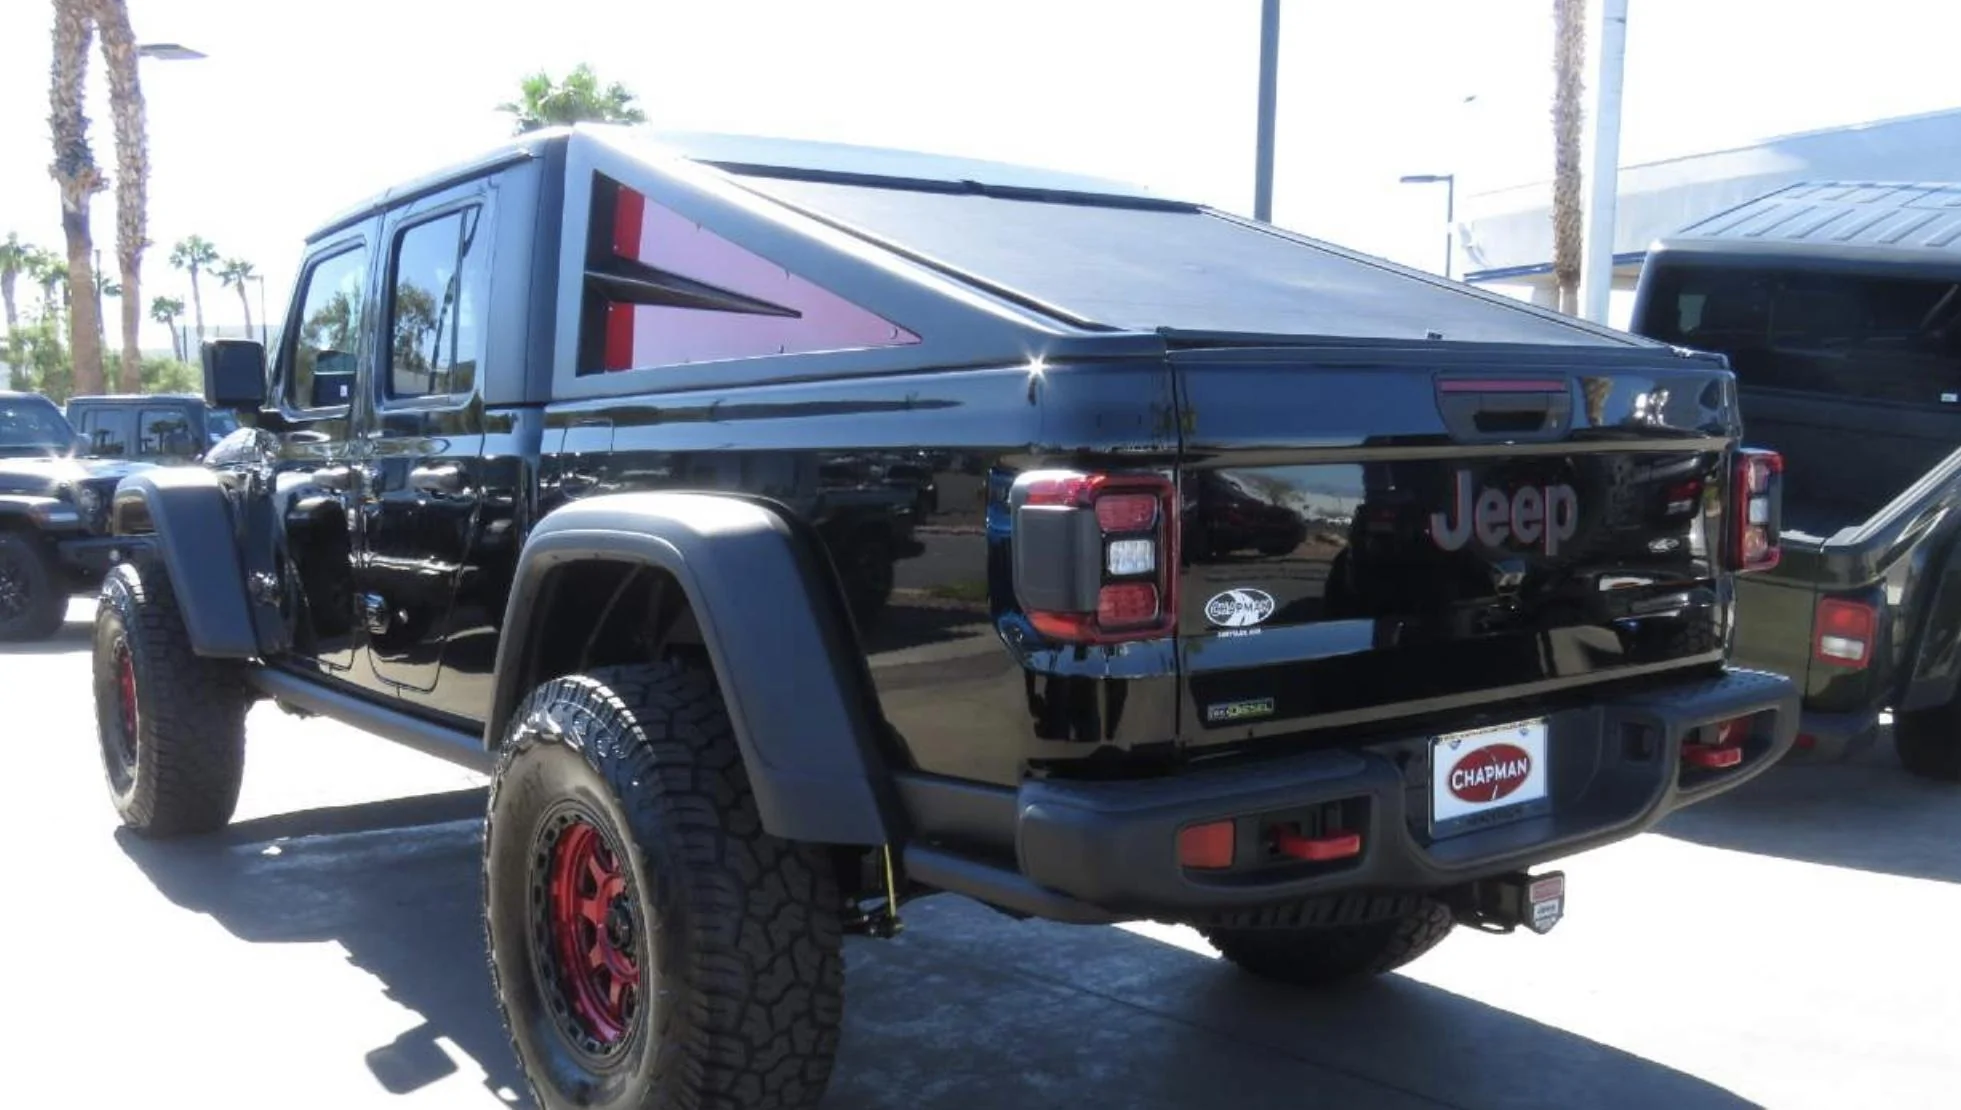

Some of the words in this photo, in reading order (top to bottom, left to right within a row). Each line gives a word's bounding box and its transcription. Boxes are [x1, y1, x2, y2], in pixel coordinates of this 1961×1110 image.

[1430, 469, 1578, 557] Jeep
[1210, 599, 1271, 617] CHAPMAN
[1451, 757, 1529, 790] CHAPMAN
